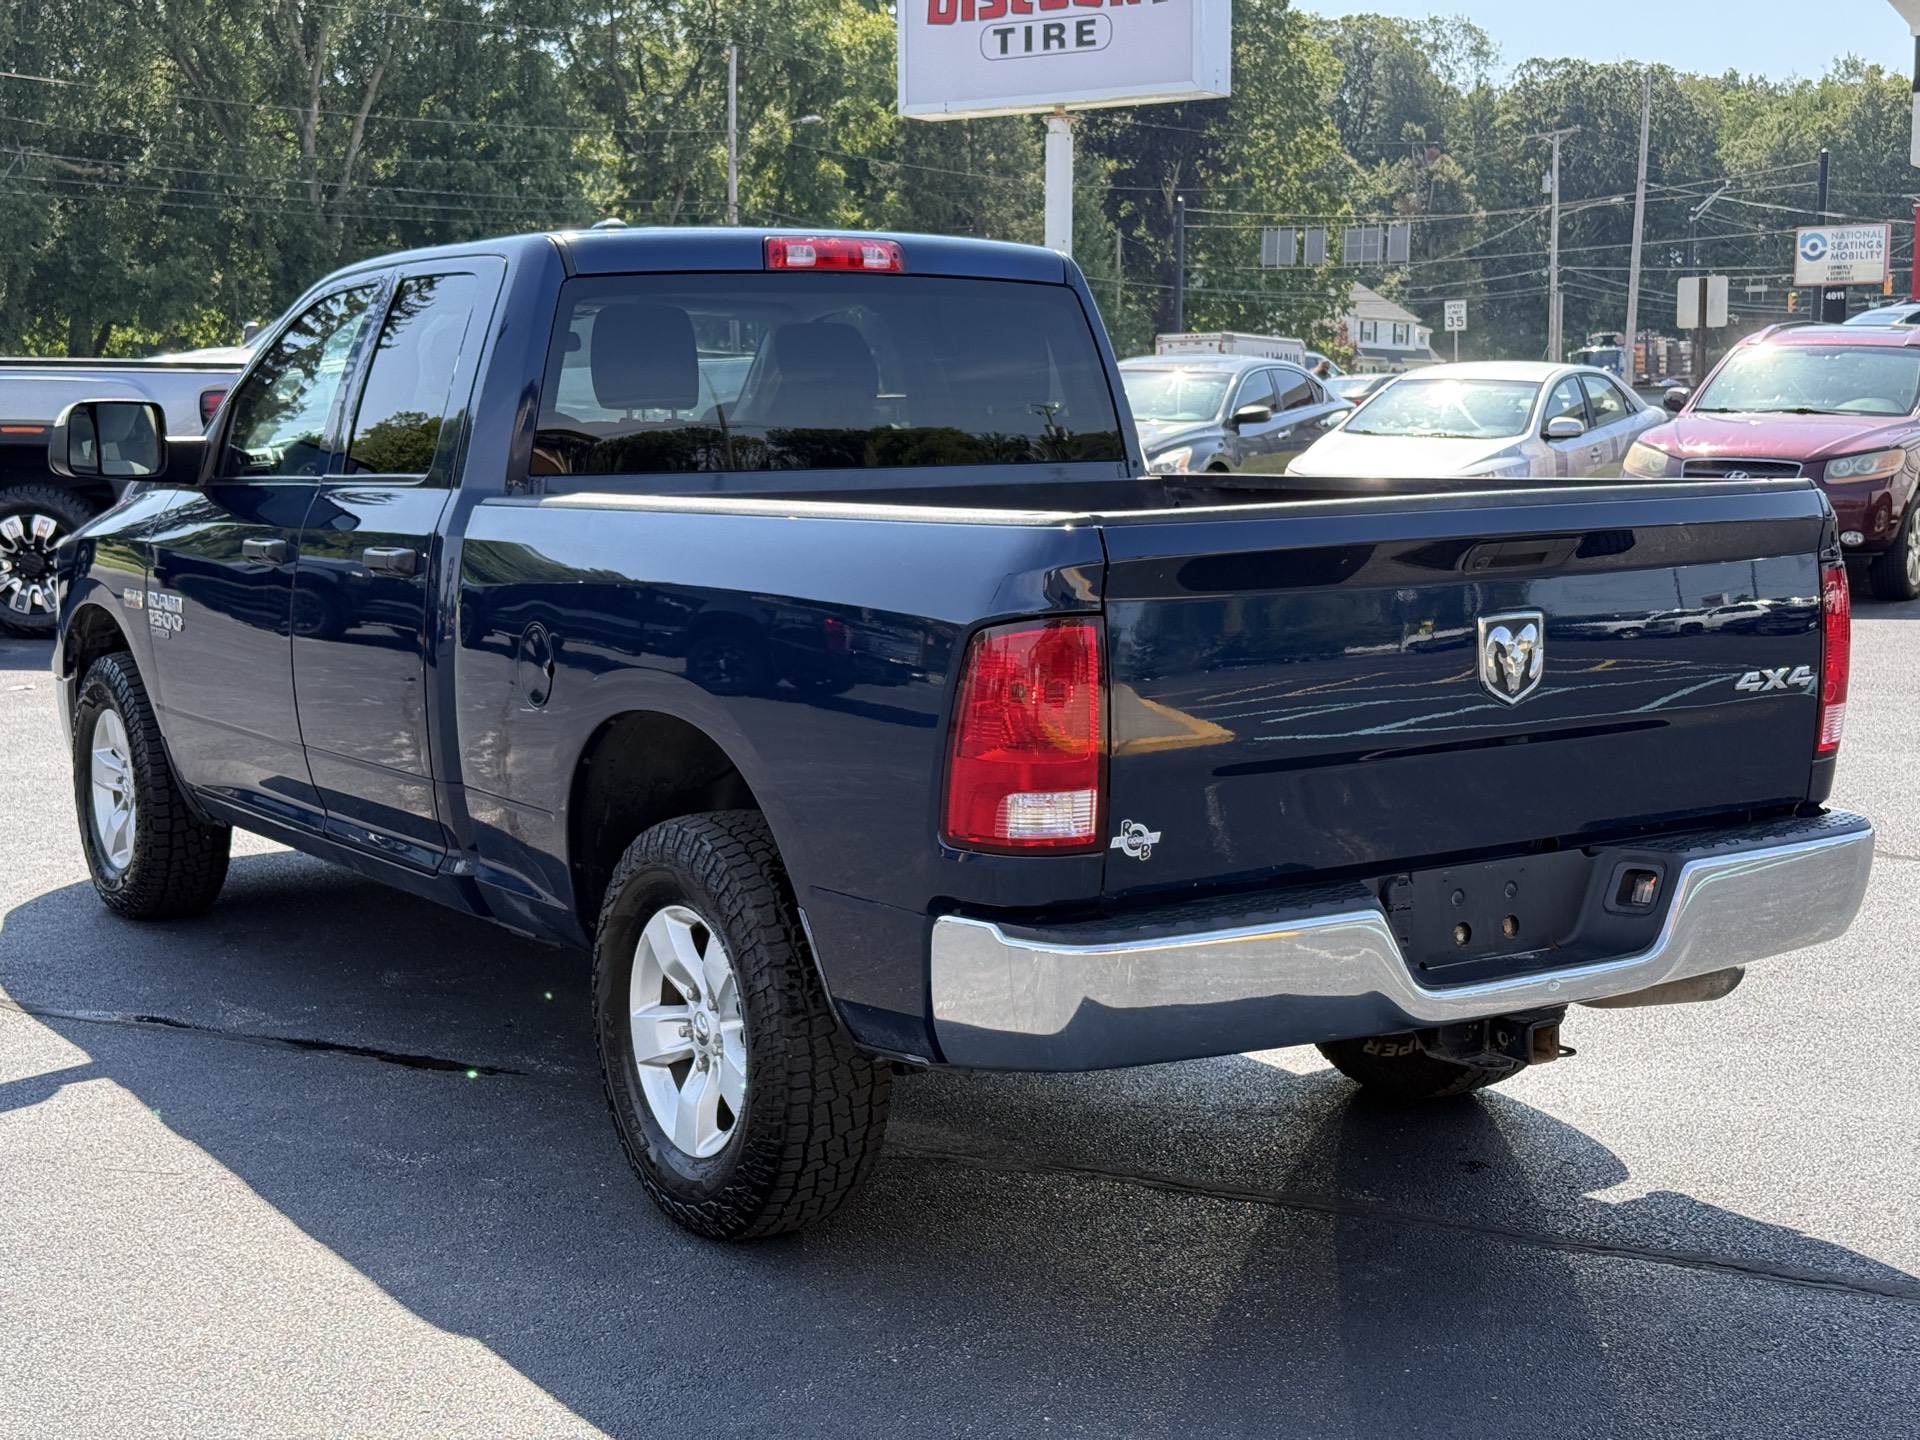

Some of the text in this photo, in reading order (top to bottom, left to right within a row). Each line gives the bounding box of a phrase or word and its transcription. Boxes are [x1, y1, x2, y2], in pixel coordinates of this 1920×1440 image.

[993, 19, 1097, 55] TIRE
[1831, 230, 1883, 240] NATIONAL
[1830, 240, 1883, 251] SEATING &
[1830, 251, 1882, 261] MOBILITY
[1825, 291, 1845, 300] 4011
[1447, 316, 1464, 327] 35
[148, 591, 182, 614] RAM
[148, 609, 184, 632] 1500
